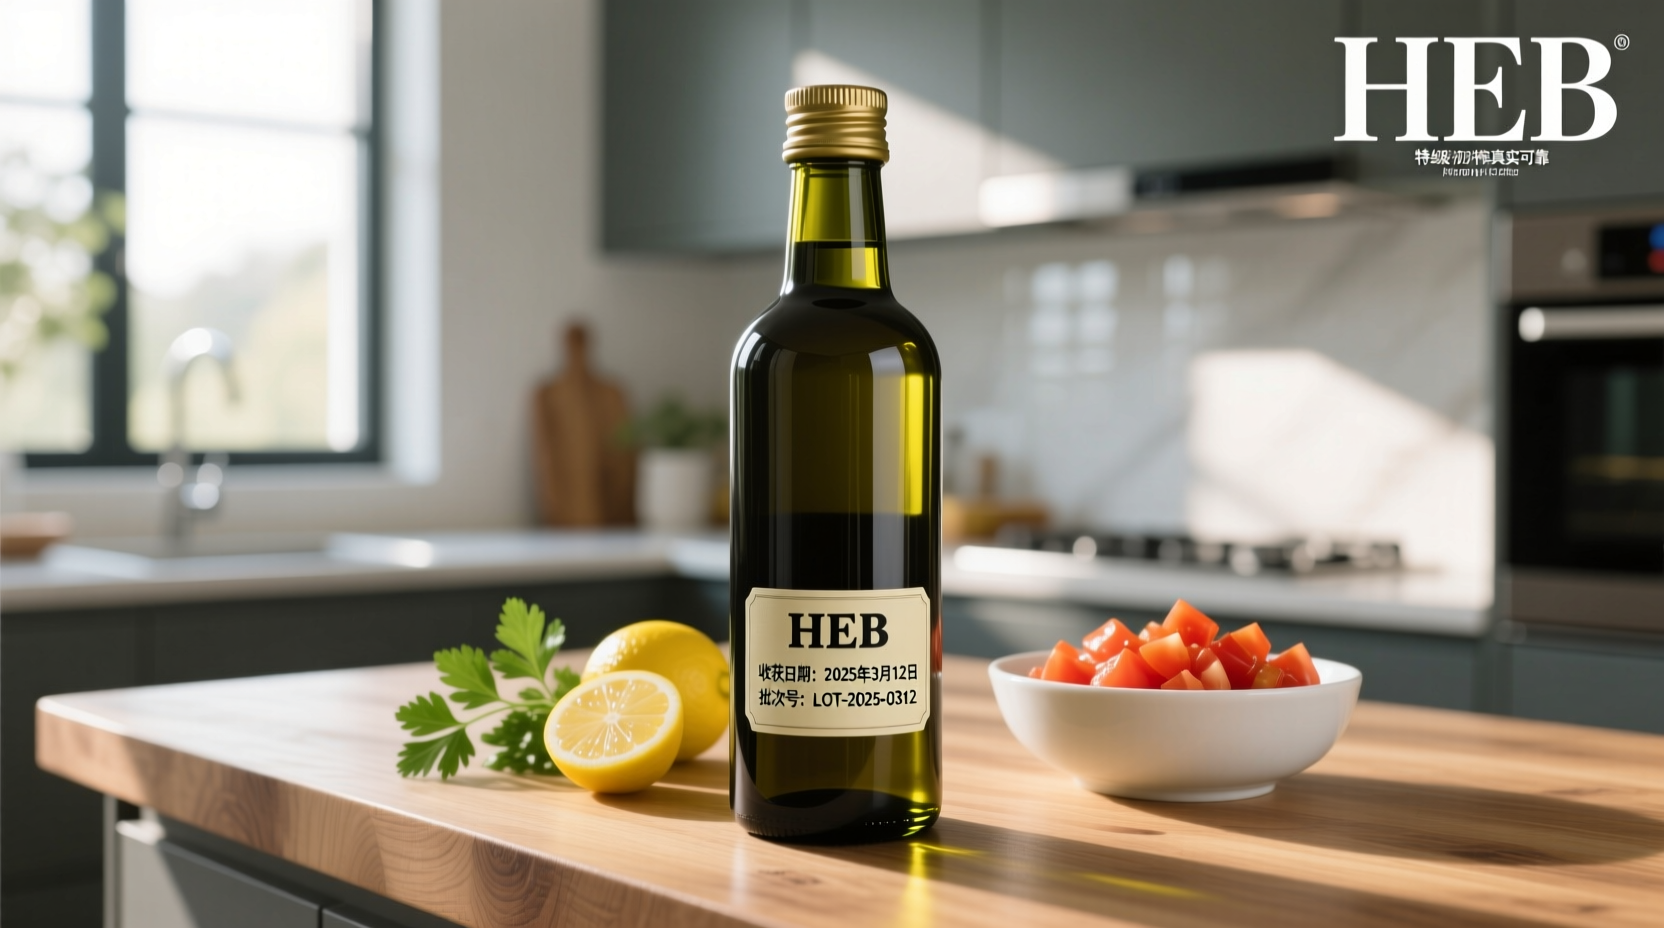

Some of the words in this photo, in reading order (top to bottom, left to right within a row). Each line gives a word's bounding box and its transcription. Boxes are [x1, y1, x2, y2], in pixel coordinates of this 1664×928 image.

[788, 612, 889, 649] HEB
[824, 664, 918, 683] 2025年3月12日
[813, 690, 918, 707] LOT-2025-0312
